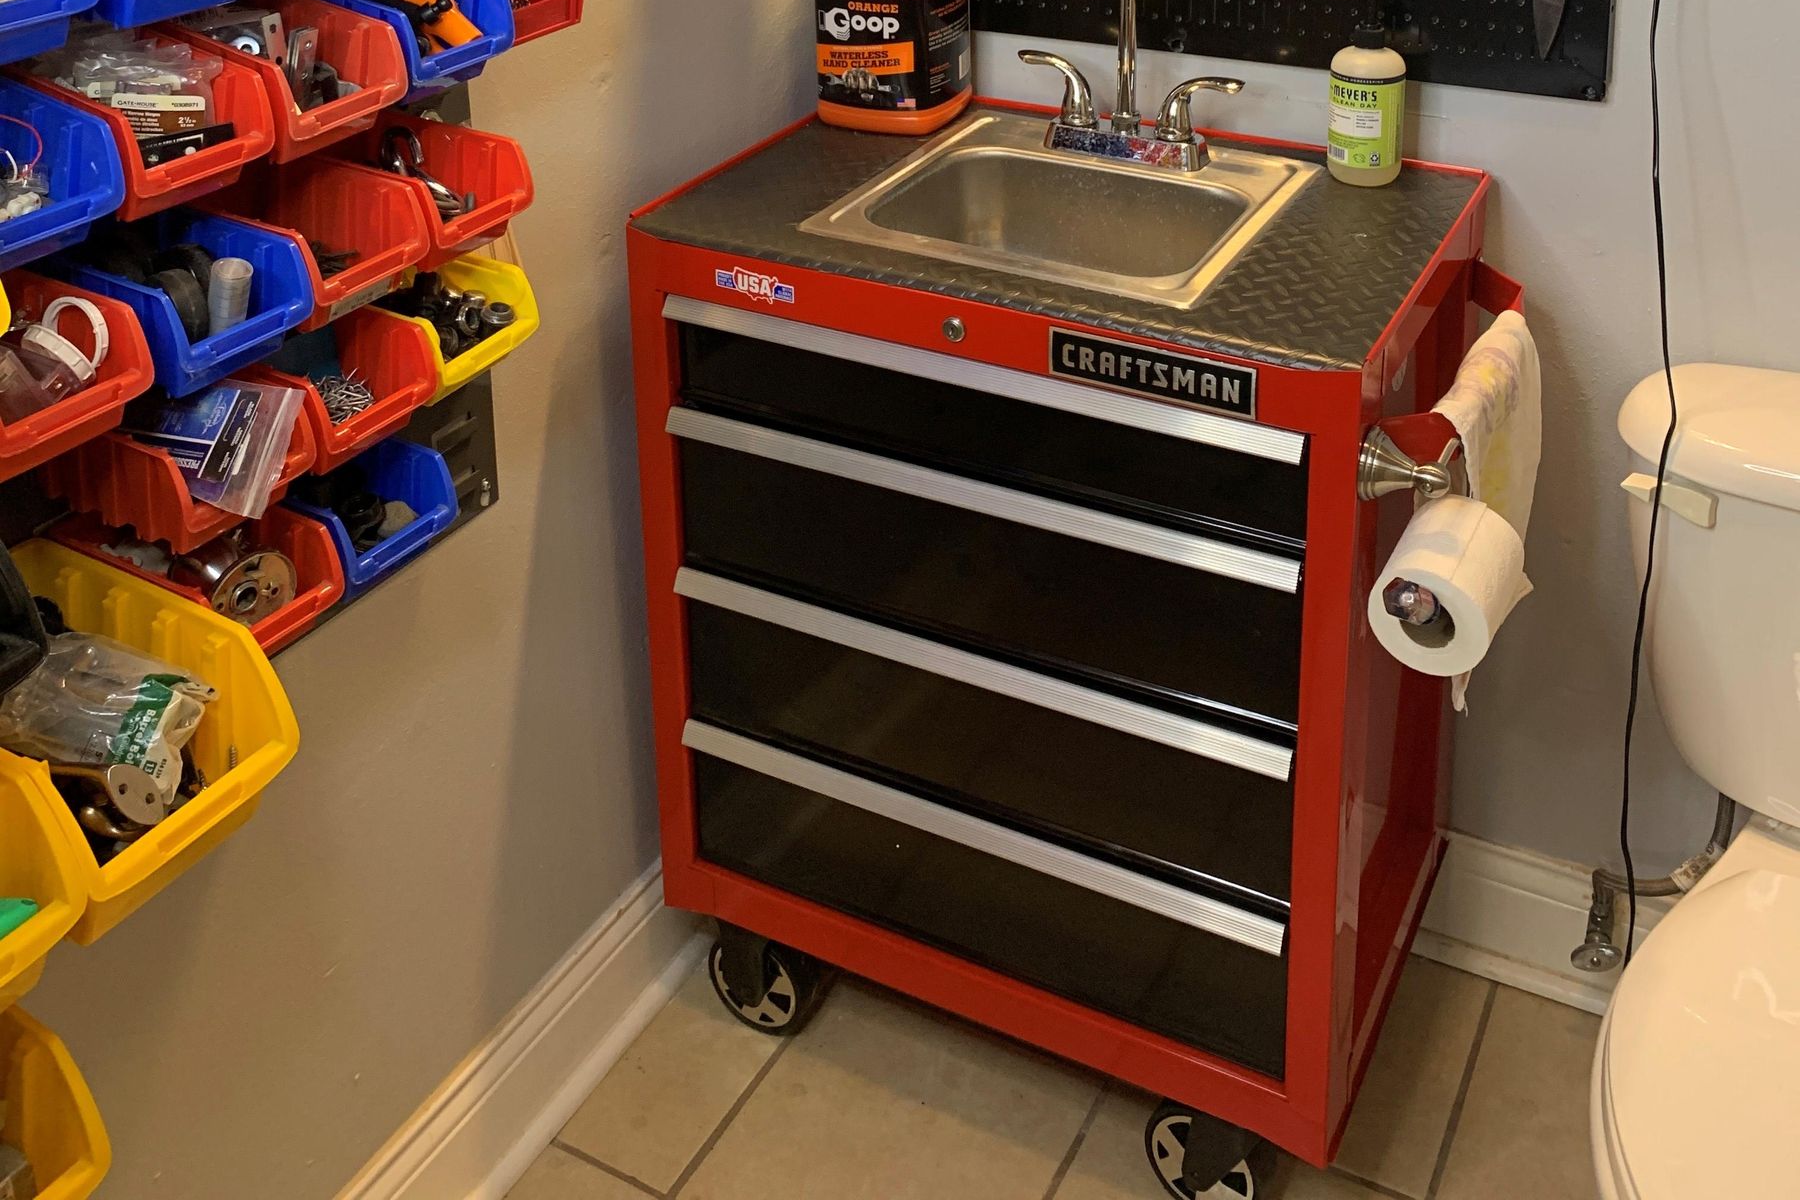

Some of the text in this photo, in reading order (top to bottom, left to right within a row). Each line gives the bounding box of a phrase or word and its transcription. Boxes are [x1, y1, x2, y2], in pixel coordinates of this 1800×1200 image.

[847, 1, 899, 14] ORANGE
[823, 57, 901, 69] HAND CLEANER
[829, 50, 889, 61] WATERLESS
[1333, 84, 1378, 102] MEYER'S
[1333, 97, 1356, 108] CLEAN
[737, 273, 772, 297] USA
[1061, 343, 1241, 405] CRAFTSMAN
[133, 708, 157, 743] Barrel
